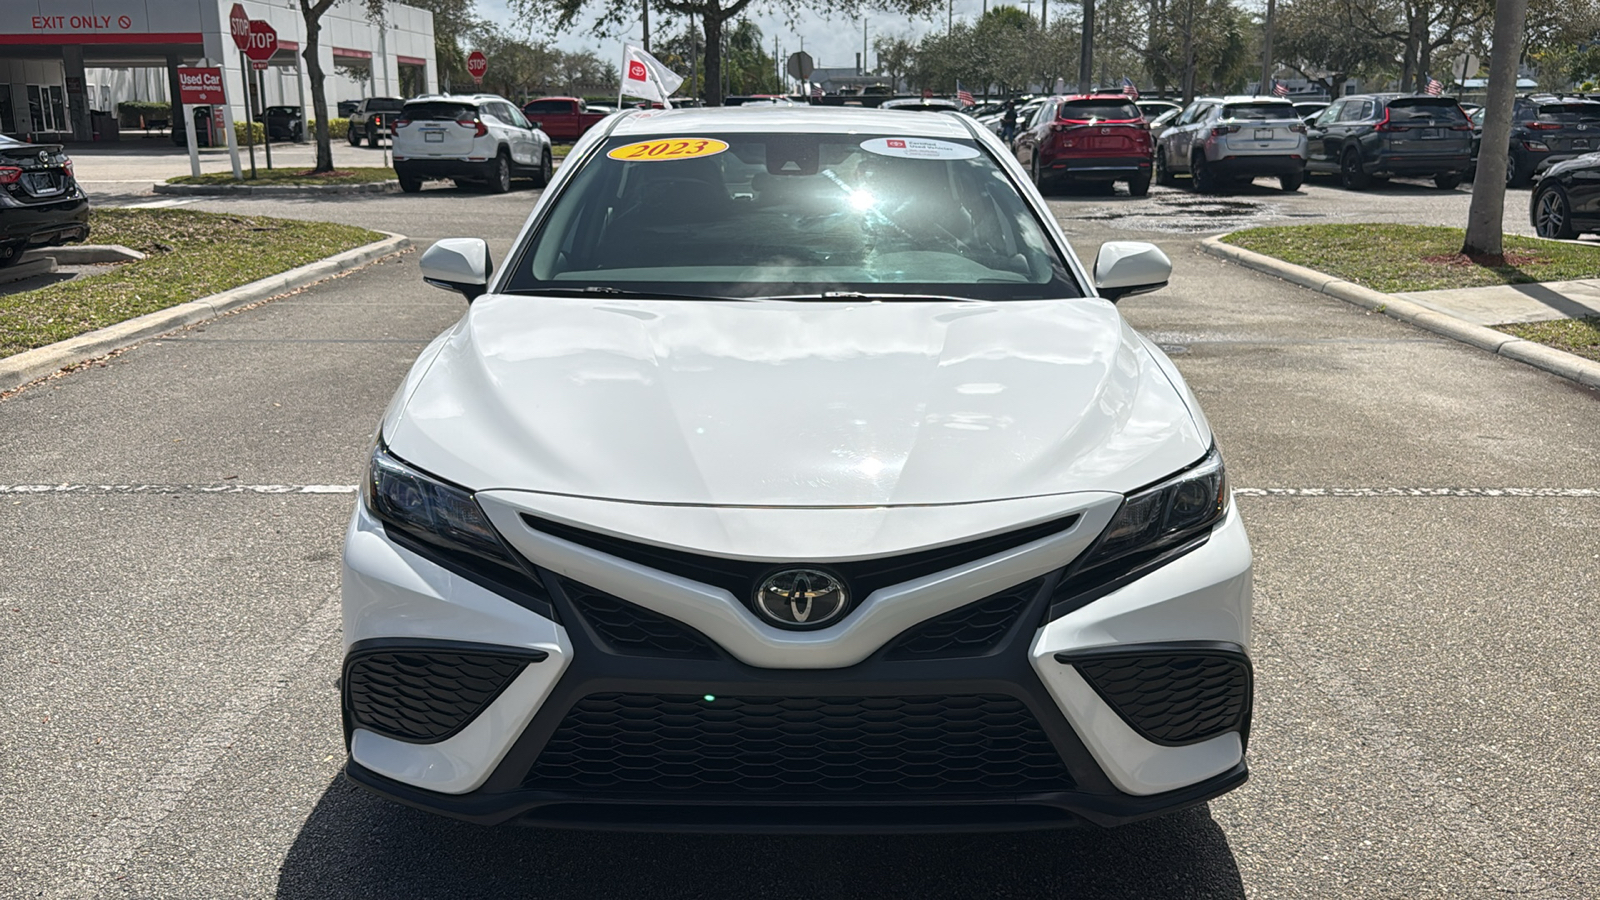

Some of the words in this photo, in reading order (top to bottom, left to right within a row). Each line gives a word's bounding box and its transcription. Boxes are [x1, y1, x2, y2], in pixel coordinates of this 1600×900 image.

[32, 16, 65, 29] EXIT
[70, 15, 111, 29] ONLY
[232, 18, 249, 36] STOP
[250, 33, 275, 48] TOP
[469, 59, 486, 70] STOP
[180, 73, 202, 84] Used
[203, 73, 220, 84] Car
[626, 141, 709, 158] 2023
